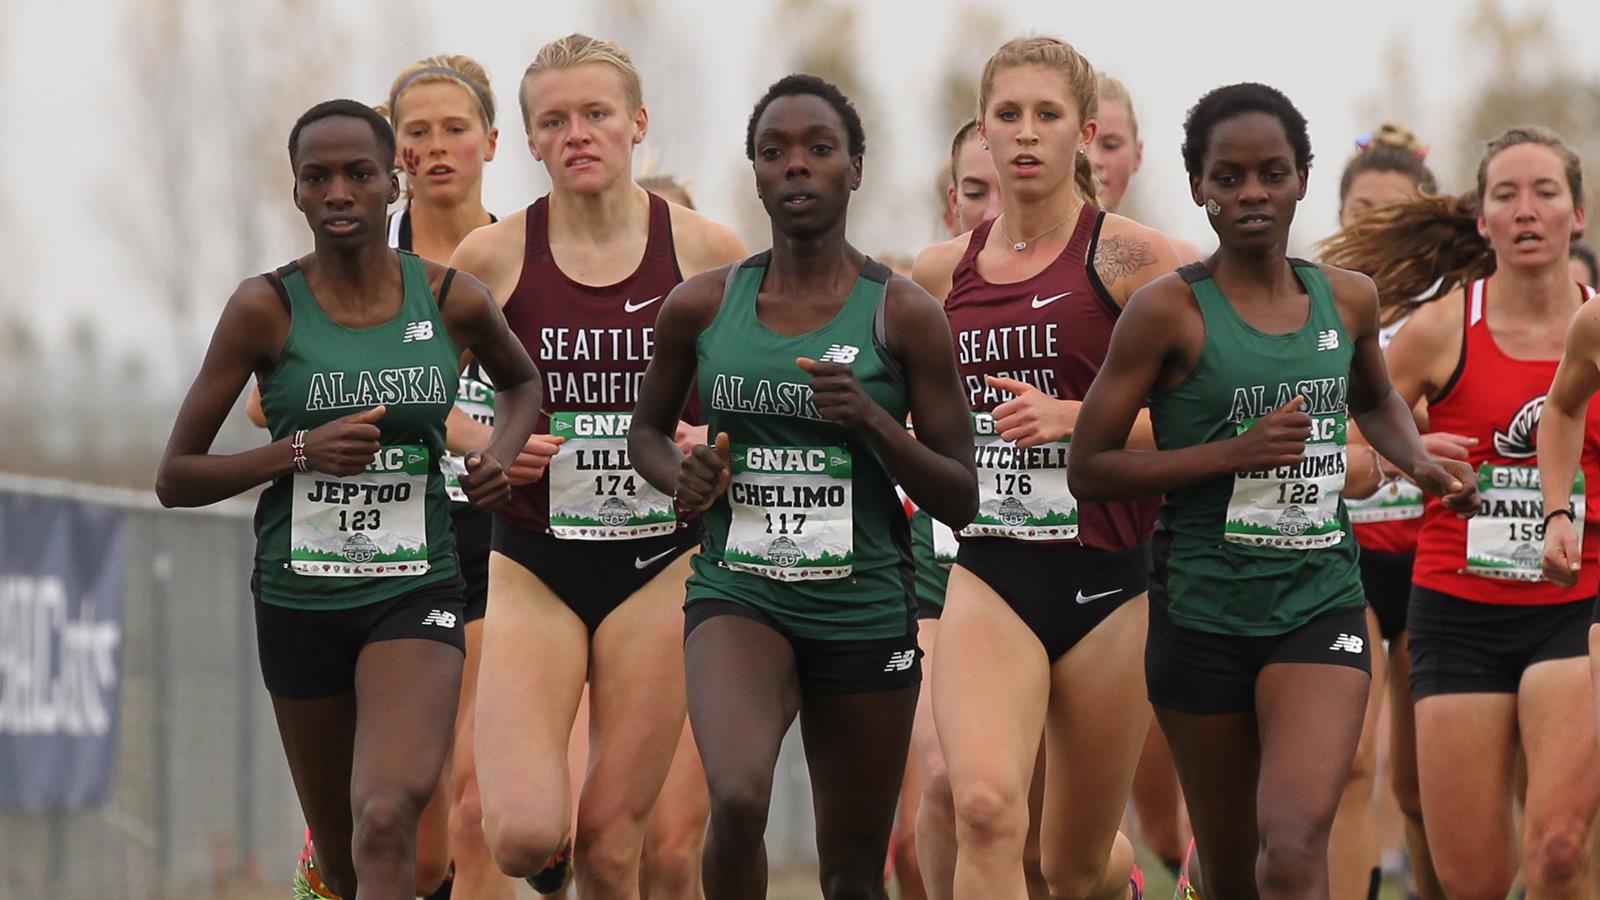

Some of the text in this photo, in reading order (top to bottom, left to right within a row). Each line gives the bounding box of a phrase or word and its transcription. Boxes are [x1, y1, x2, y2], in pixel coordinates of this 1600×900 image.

[540, 327, 655, 361] SEATTLE
[959, 323, 1058, 364] SEATTLE
[306, 366, 447, 411] ALASKA
[457, 378, 487, 402] AC
[711, 374, 823, 420] ALASK
[575, 414, 633, 436] GNA
[1304, 418, 1336, 441] AC
[366, 448, 404, 471] AC
[746, 447, 826, 472] GNAC
[975, 446, 1068, 470] ITCHELL
[307, 481, 412, 504] JEPTOO
[595, 475, 636, 496] 174
[731, 482, 845, 509] CHELIMO
[995, 472, 1032, 496] 176
[1276, 483, 1320, 505] 122
[338, 509, 381, 532] 123
[765, 512, 807, 535] 117
[1508, 522, 1545, 542] 159
